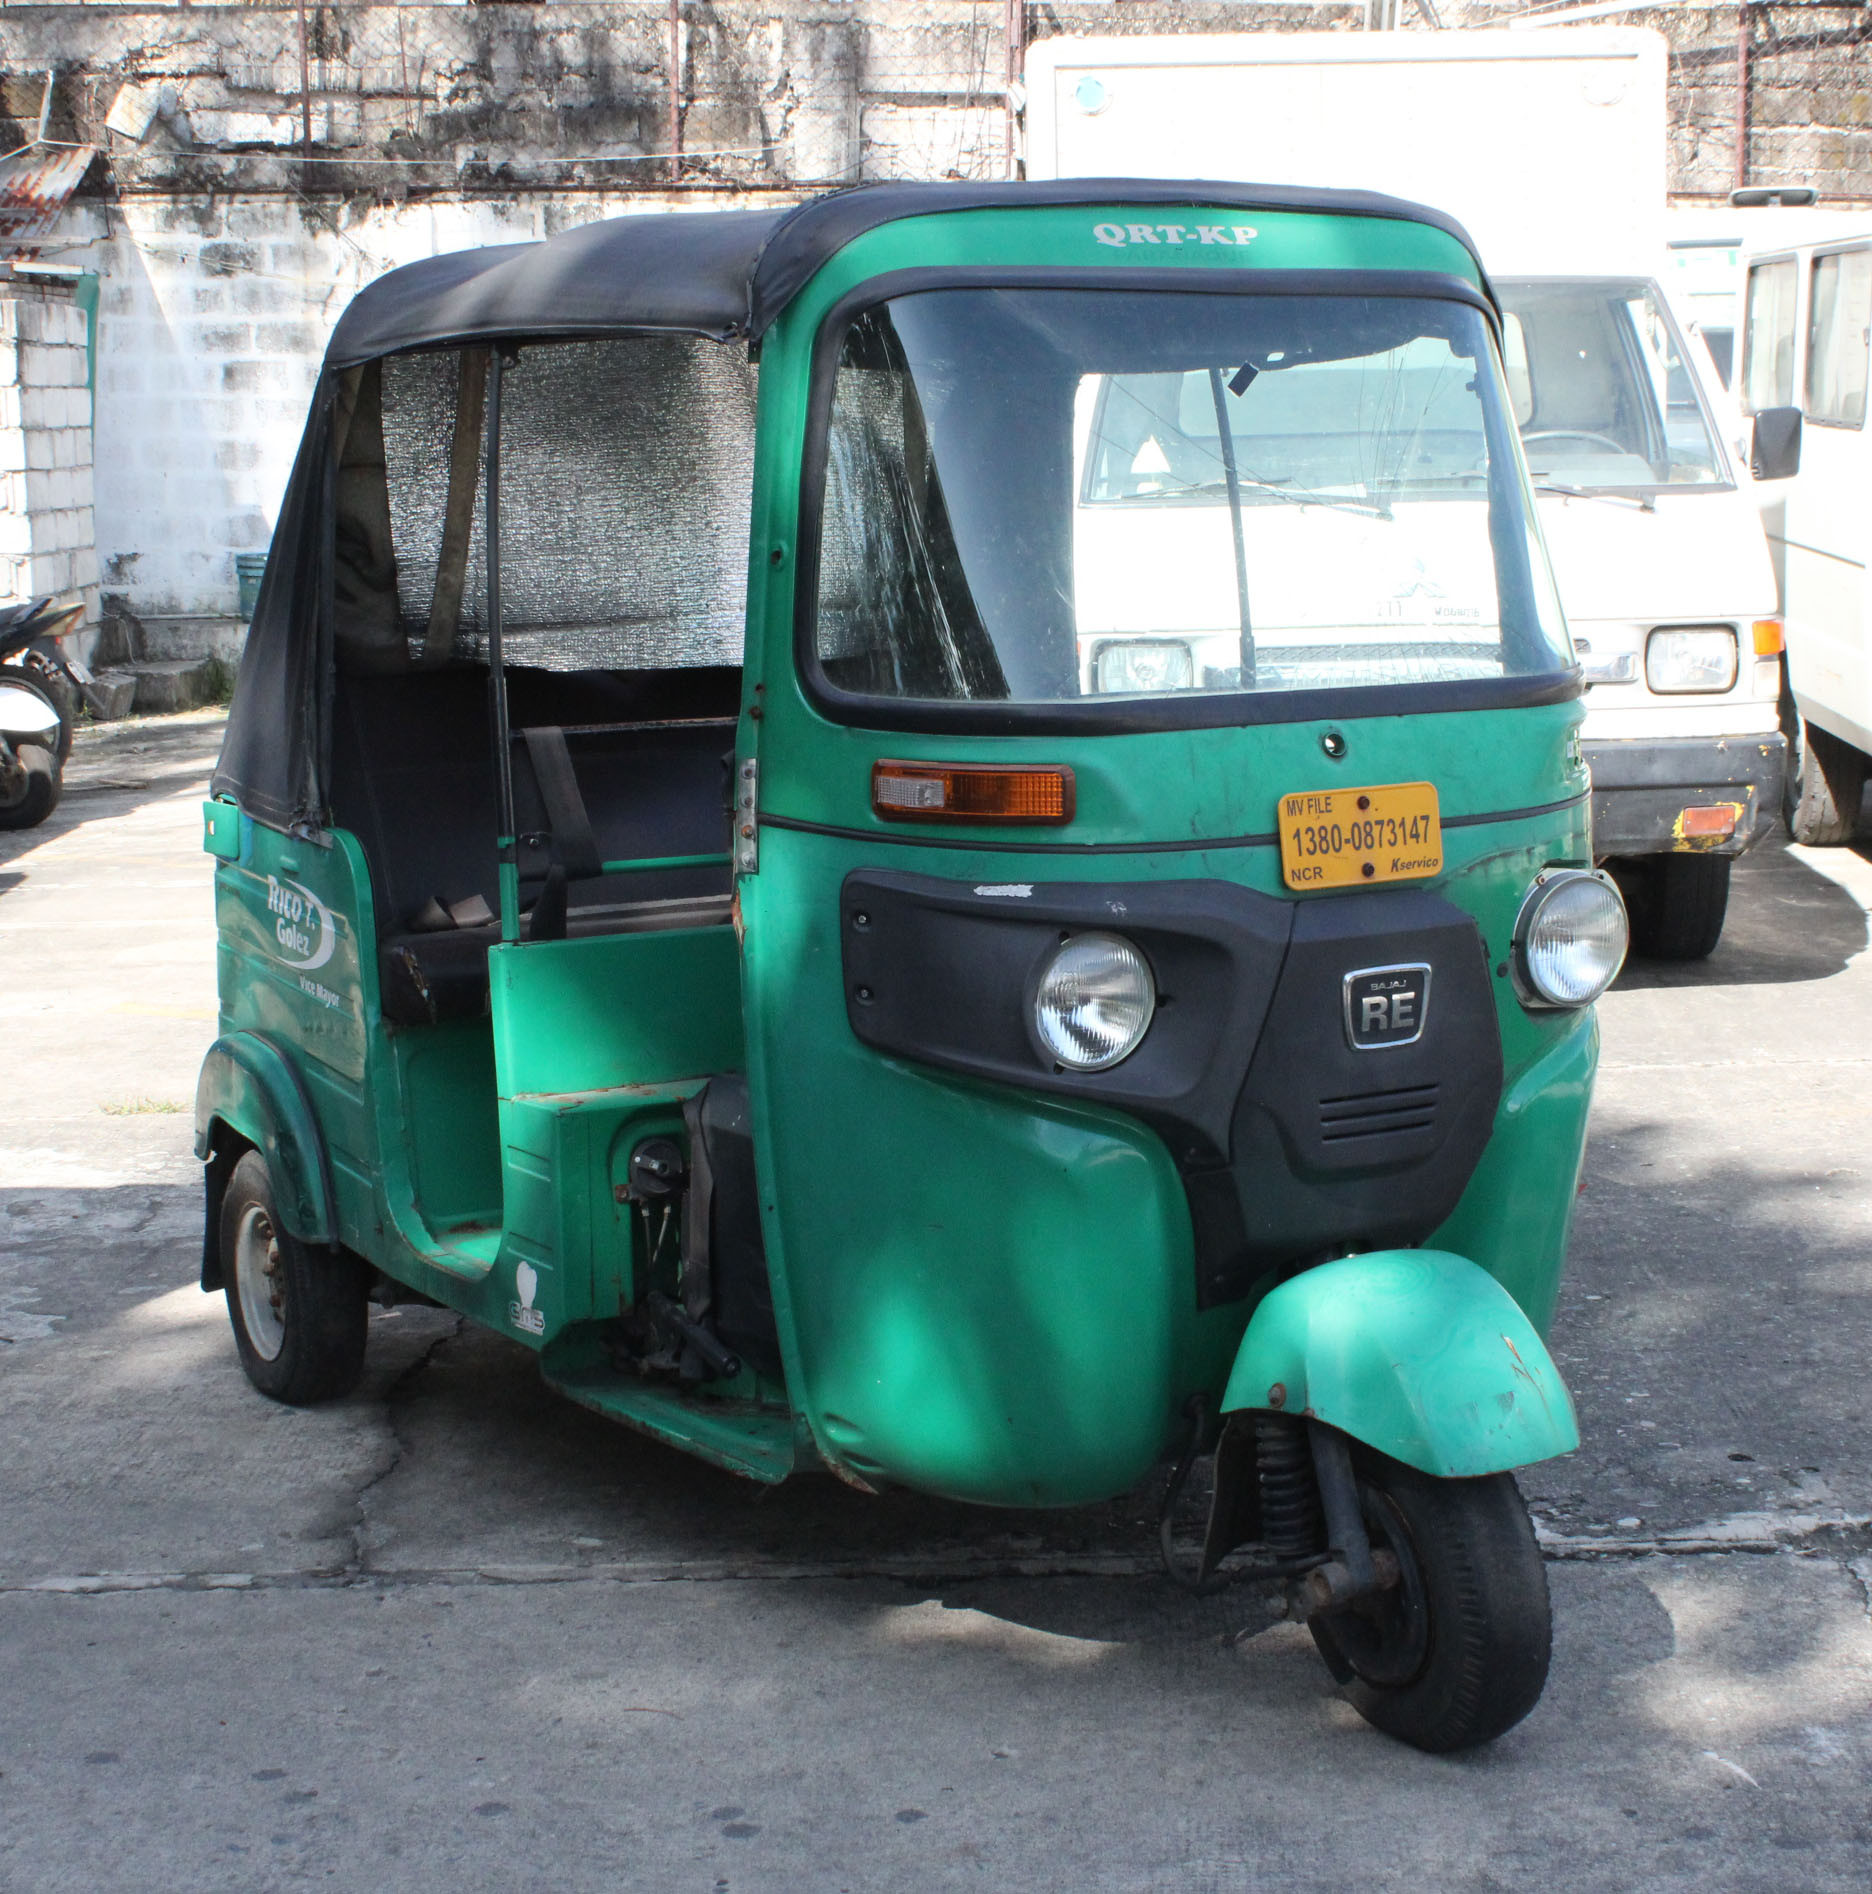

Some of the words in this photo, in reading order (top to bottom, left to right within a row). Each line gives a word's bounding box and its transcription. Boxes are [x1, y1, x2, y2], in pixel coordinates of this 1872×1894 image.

[1093, 223, 1259, 248] QRT-KP
[1286, 799, 1304, 817] MV
[1307, 796, 1333, 815] FILE
[1293, 814, 1431, 857] 1380-0873147
[1291, 866, 1324, 882] NCR
[277, 917, 310, 956] Golez
[299, 975, 316, 996] Vice
[316, 982, 339, 1009] Mayor
[1370, 979, 1407, 991] BAJAJ
[1361, 991, 1417, 1032] RE
